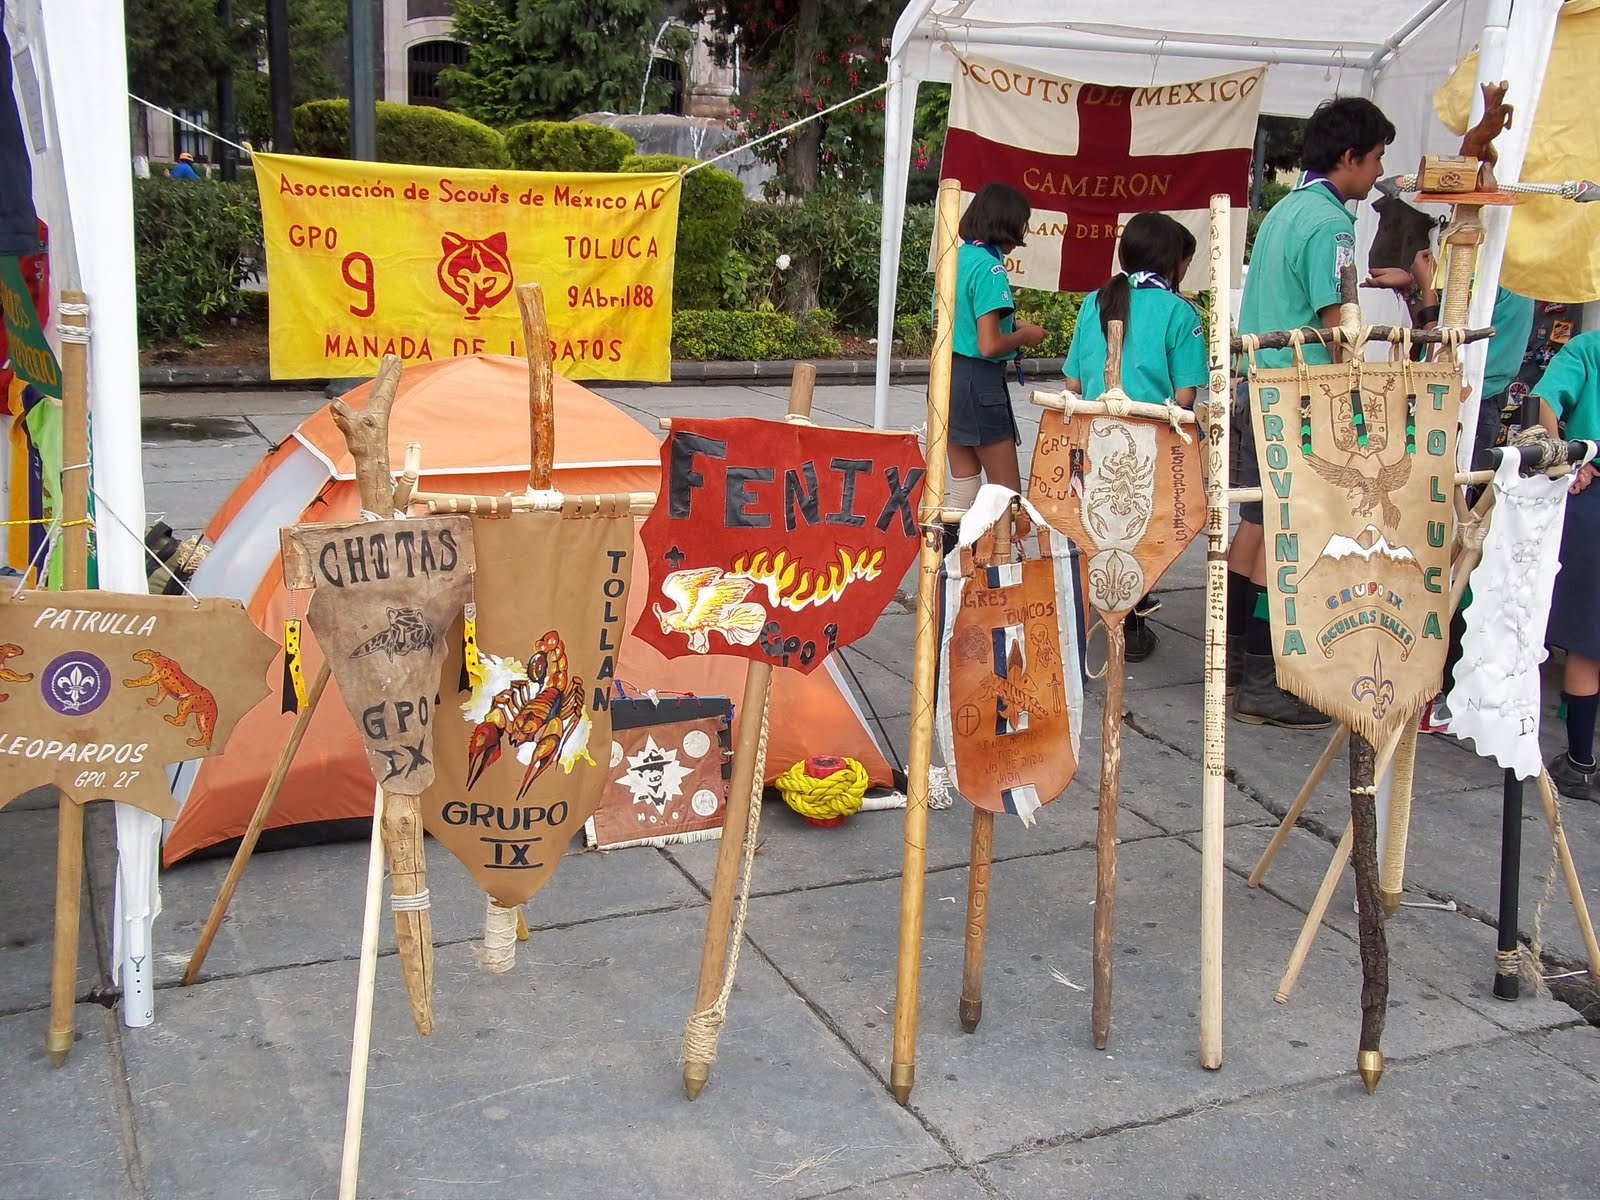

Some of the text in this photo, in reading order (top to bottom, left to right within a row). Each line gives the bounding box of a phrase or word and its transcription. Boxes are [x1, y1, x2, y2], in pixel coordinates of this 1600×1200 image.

[1083, 83, 1124, 107] DE
[1135, 74, 1259, 107] MEXICO
[279, 173, 395, 199] Asociación
[404, 182, 430, 201] de
[438, 178, 510, 205] Scouts
[519, 188, 545, 207] de
[554, 184, 628, 210] México
[1023, 168, 1173, 198] CAMERON
[288, 224, 338, 250] GPO
[1026, 222, 1068, 236] LAN
[1075, 223, 1099, 239] DE
[564, 235, 658, 260] TOLUCA
[342, 251, 376, 318] 9
[325, 334, 623, 362] MANADA DE LBATOS
[1040, 434, 1078, 456] GRU
[668, 431, 927, 538] FENIX
[1032, 473, 1068, 501] TOLU
[1051, 466, 1065, 483] 9
[1258, 387, 1307, 656] PROVINCIA
[1421, 384, 1450, 640] TOLUCA
[318, 528, 459, 588] CHITAS
[961, 590, 1008, 609] GRES
[1324, 581, 1385, 611] GRUPO
[33, 607, 157, 637] PATRULLA
[592, 550, 627, 713] TOLLAN
[823, 622, 839, 652] 9
[1321, 609, 1377, 647] AGUILAS
[362, 700, 431, 742] GPO
[0, 733, 149, 764] LEOPARDOS
[374, 735, 432, 784] IX
[74, 770, 140, 789] GPO. 27
[441, 800, 569, 831] GRUPO
[490, 840, 535, 868] IX
